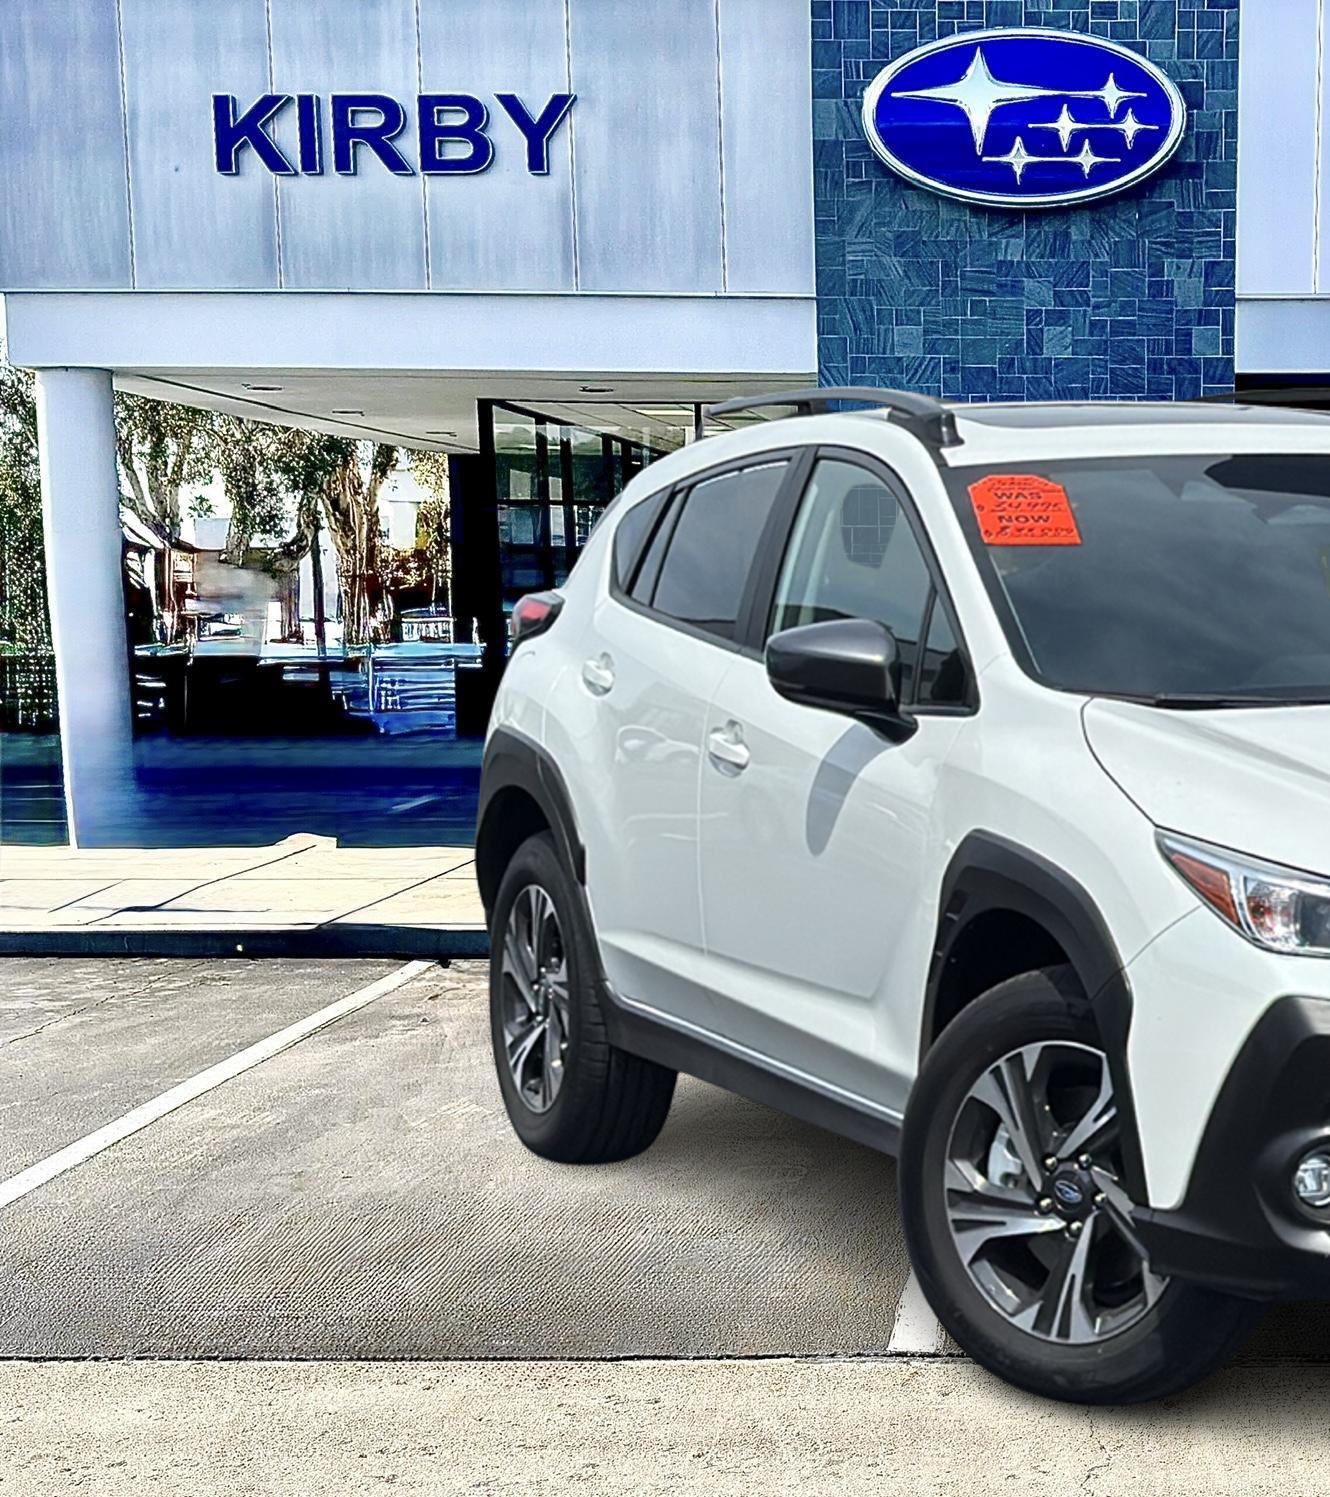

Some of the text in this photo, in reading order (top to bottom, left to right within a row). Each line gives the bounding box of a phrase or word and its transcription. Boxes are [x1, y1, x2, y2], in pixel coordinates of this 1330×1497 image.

[212, 93, 578, 175] KIRBY
[993, 491, 1042, 500] WAS
[997, 514, 1050, 524] NOW
